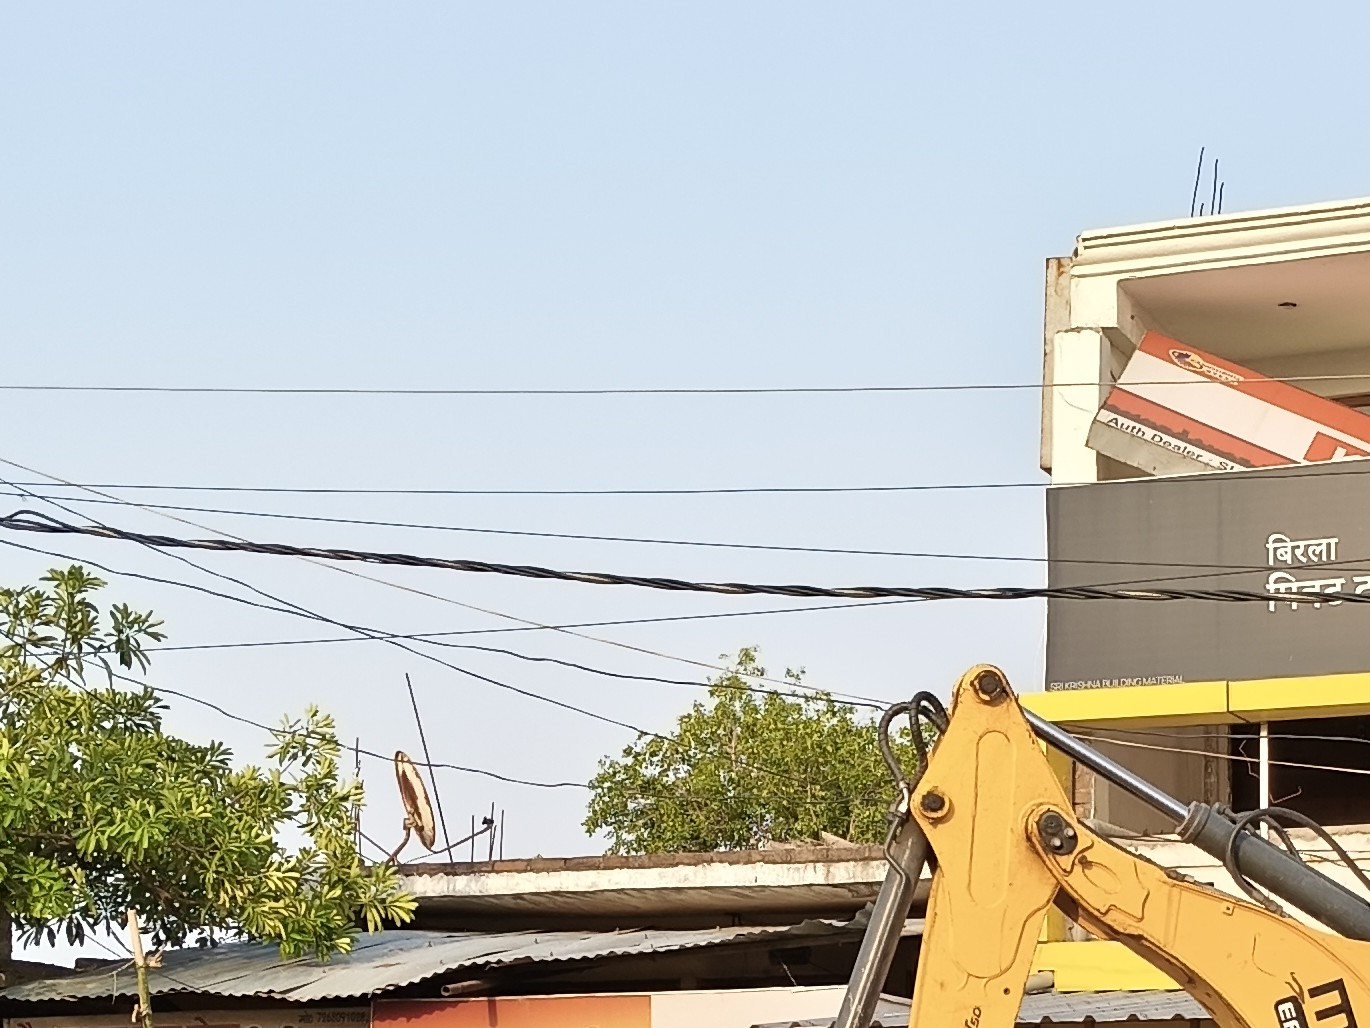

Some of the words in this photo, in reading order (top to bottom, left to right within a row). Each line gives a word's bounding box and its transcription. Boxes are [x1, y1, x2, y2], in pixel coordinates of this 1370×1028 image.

[1106, 417, 1146, 439] Auth
[1150, 433, 1204, 461] Dealer
[1265, 533, 1339, 566] बिरला
[1050, 682, 1064, 692] SRI
[1064, 680, 1101, 691] KRISHNA
[1102, 677, 1142, 688] BUILDING
[1142, 674, 1184, 686] MATERIAL
